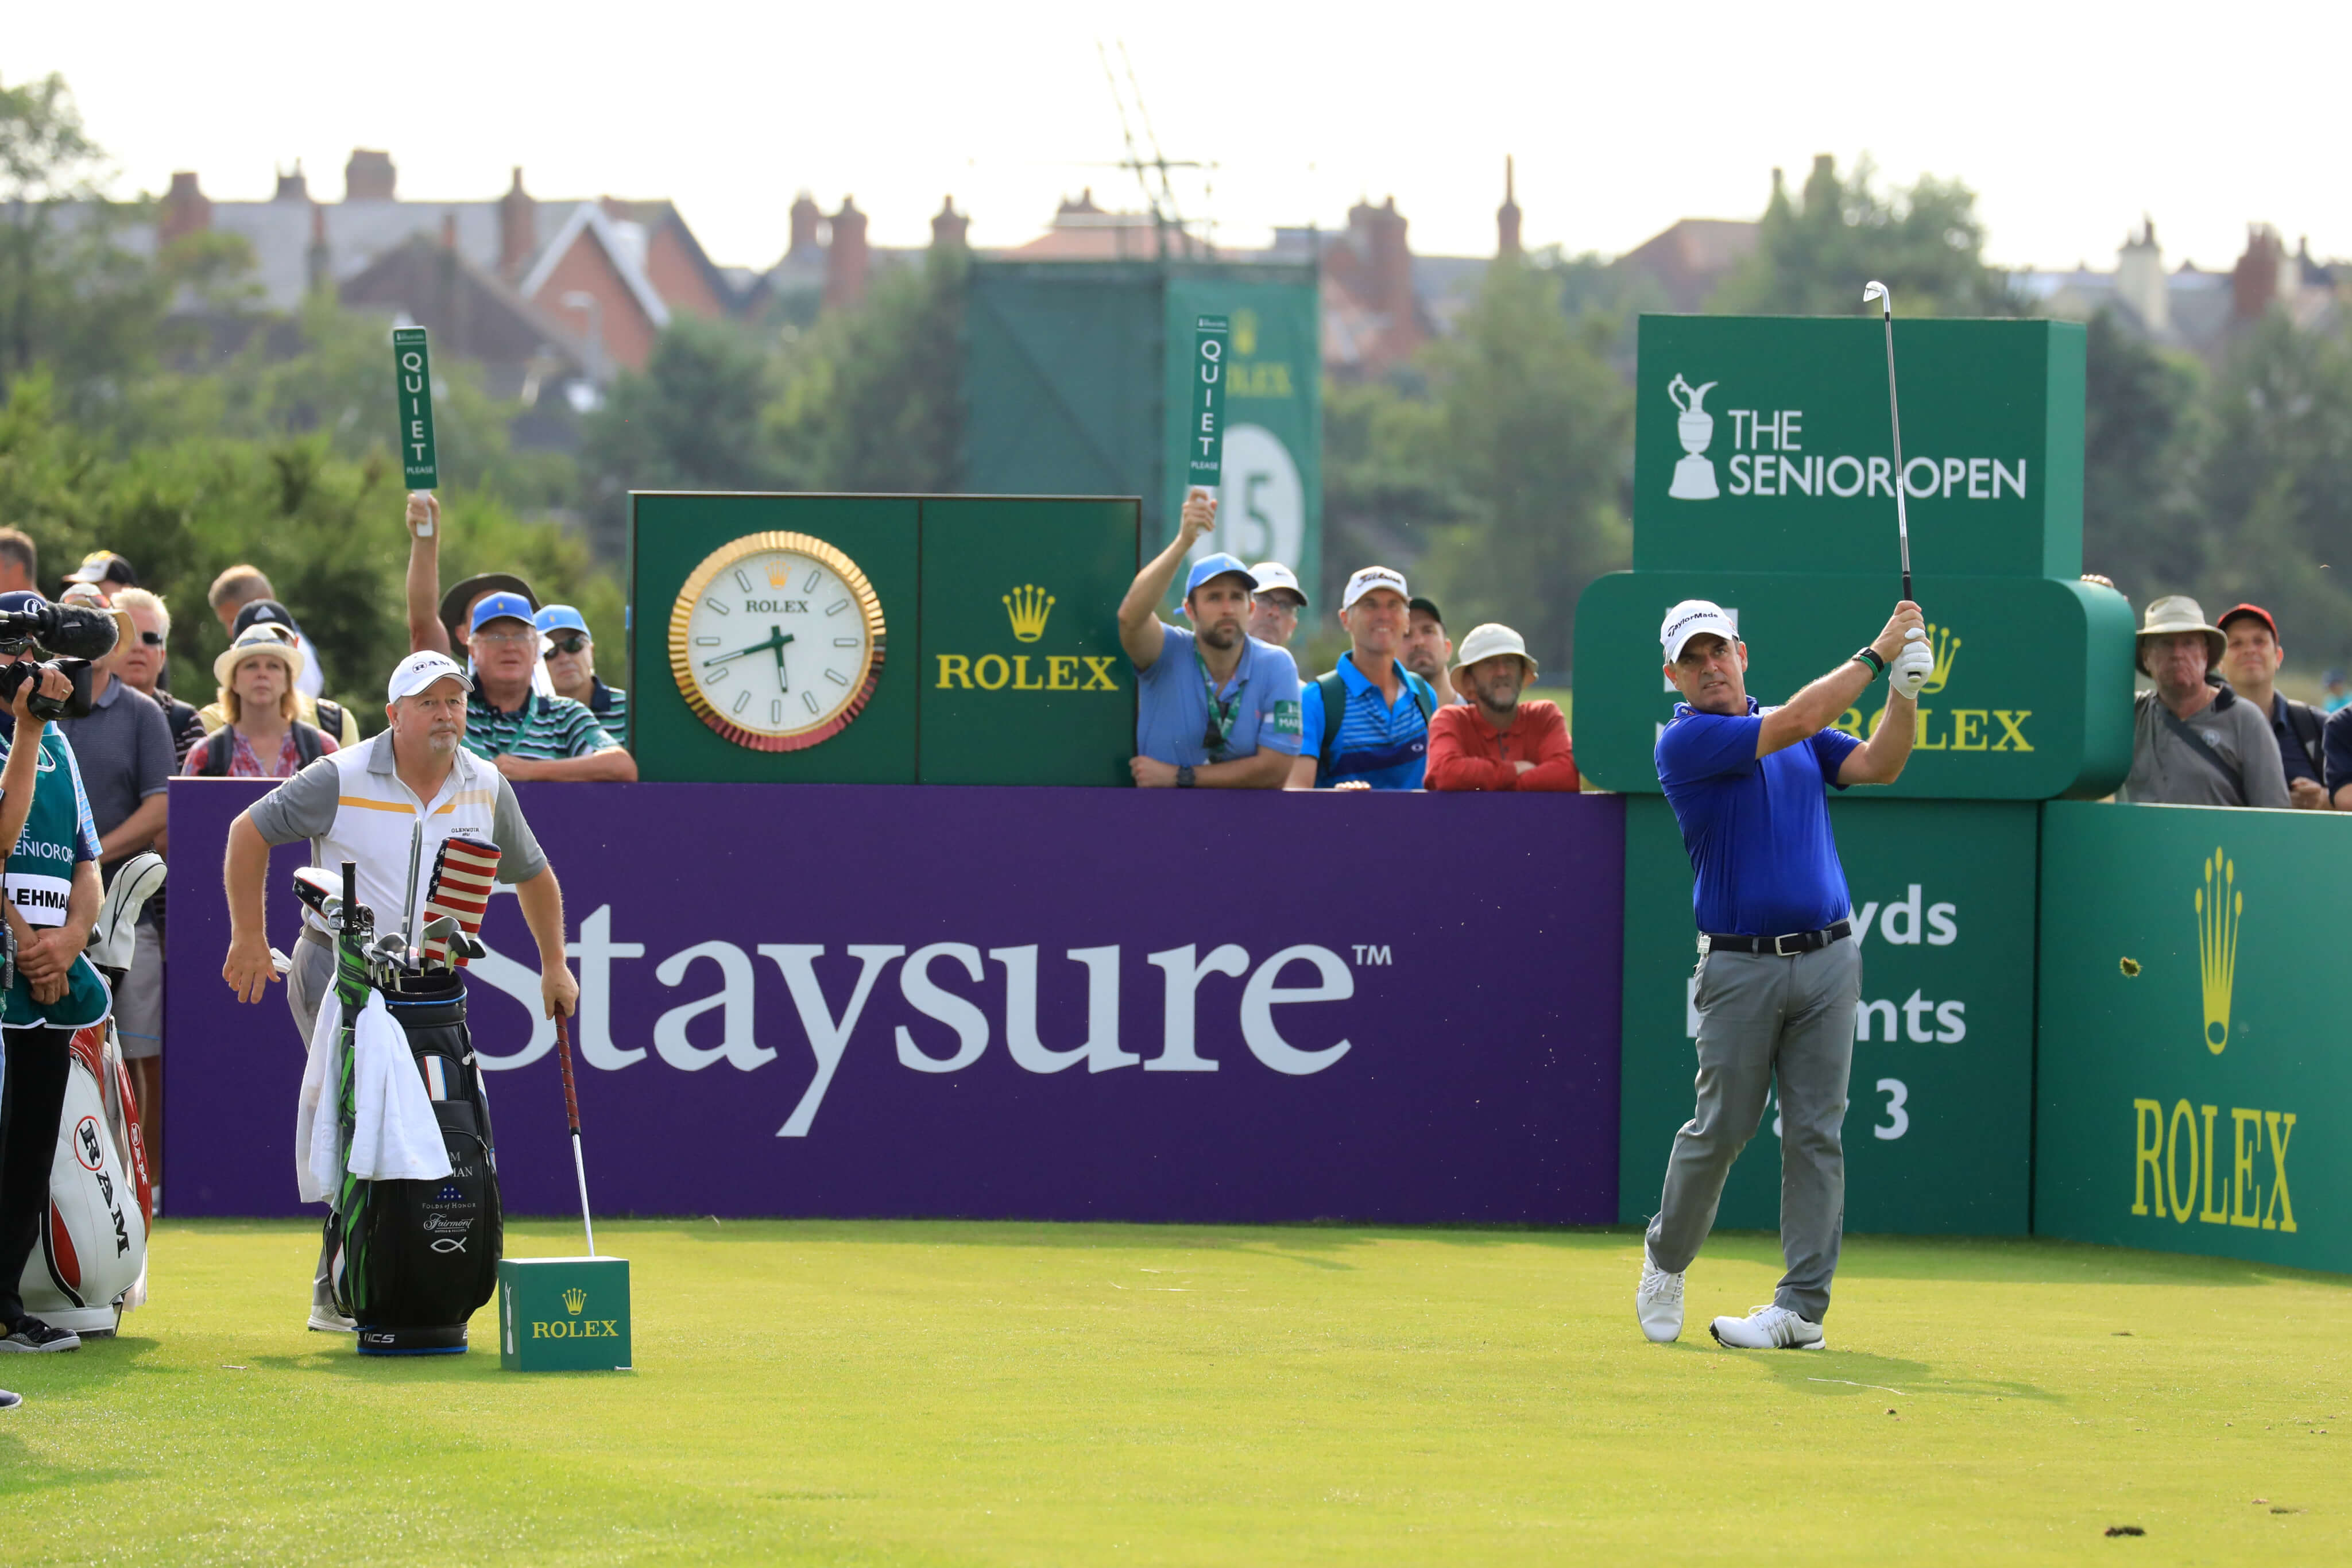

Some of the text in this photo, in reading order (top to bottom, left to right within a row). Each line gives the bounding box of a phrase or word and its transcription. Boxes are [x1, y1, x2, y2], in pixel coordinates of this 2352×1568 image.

[402, 351, 427, 461] QUIET
[1198, 339, 1222, 456] QUIET
[1728, 409, 1802, 451] THE
[405, 465, 435, 475] PLEASE
[1190, 460, 1218, 471] PLEASE
[746, 601, 809, 613] ROLEX
[1667, 611, 1719, 637] TaylorMade
[413, 660, 451, 674] RAM
[935, 654, 1119, 691] ROLEX
[5, 886, 69, 911] LEHMA
[1874, 1078, 1909, 1140] 3
[2130, 1097, 2298, 1234] ROLEX
[75, 1116, 130, 1259] RAM
[423, 1213, 475, 1230] Fairmont
[532, 1319, 620, 1339] ROLEX
